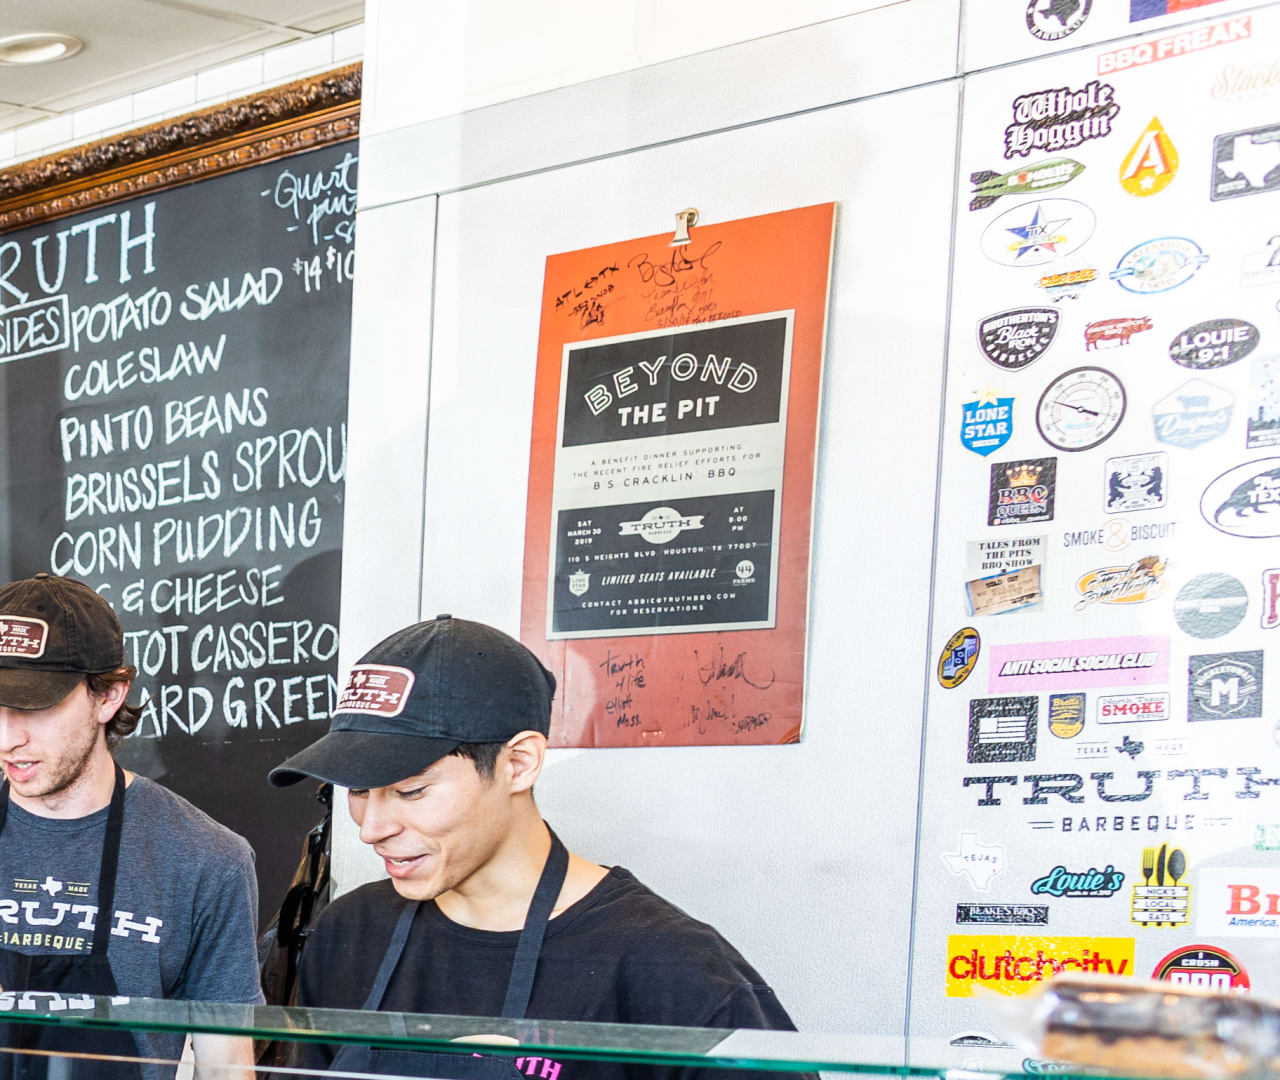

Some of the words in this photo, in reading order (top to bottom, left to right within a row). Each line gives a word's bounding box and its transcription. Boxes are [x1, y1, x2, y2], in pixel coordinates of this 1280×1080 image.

[1099, 44, 1152, 74] BBQ
[1157, 17, 1250, 60] FREAK
[1014, 82, 1114, 122] Whole
[71, 286, 172, 353] POTATO
[180, 266, 283, 322] SALAD
[1180, 326, 1250, 349] LOUIE
[65, 334, 226, 400] COLESLAW
[584, 353, 758, 416] BEYOND
[618, 402, 667, 427] THE
[678, 396, 720, 420] PIT
[965, 404, 1009, 423] LONE
[60, 404, 153, 463] PINTO
[165, 387, 269, 444] BEANS
[964, 422, 1008, 439] STAR
[601, 455, 638, 465] BENEFIT
[643, 452, 678, 461] DINNER
[683, 443, 743, 456] SUPPORTING
[593, 467, 627, 477] RECENT
[632, 464, 652, 472] FIRE
[657, 460, 689, 470] RELIEF
[695, 455, 736, 466] EFFORTS
[742, 452, 761, 460] FOR
[707, 467, 736, 479] BBQ
[65, 450, 221, 521] BRUSSELS
[998, 486, 1048, 505] BBQ
[997, 504, 1048, 517] QUEEN
[567, 529, 591, 537] MARCH
[630, 519, 692, 532] TRUTH
[1063, 531, 1105, 548] SMOKE
[1131, 522, 1176, 541] BISCUIT
[50, 521, 141, 577] CORN
[153, 497, 322, 567] PUDDING
[979, 540, 1009, 550] TALES
[1012, 538, 1040, 547] FROM
[594, 552, 630, 561] HEIGHTS
[985, 551, 1006, 559] THE
[1009, 549, 1031, 558] PITS
[981, 561, 1002, 569] BBQ
[1005, 559, 1034, 567] SHOW
[601, 574, 635, 586] LIMITED
[638, 571, 665, 583] SEATS
[667, 568, 718, 581] AVAILABLE
[122, 578, 144, 616] &
[151, 564, 285, 616] CHEESE
[582, 599, 622, 609] CONTACT
[633, 604, 705, 615] RESERVATIONS
[191, 618, 339, 674] CASSERO
[1101, 701, 1165, 716] SMOKE
[1061, 814, 1195, 833] BARBEQUE
[962, 853, 998, 864] TEJAS
[14, 881, 37, 890] TEXAS
[68, 884, 89, 893] MADE
[1033, 865, 1124, 895] Louie's
